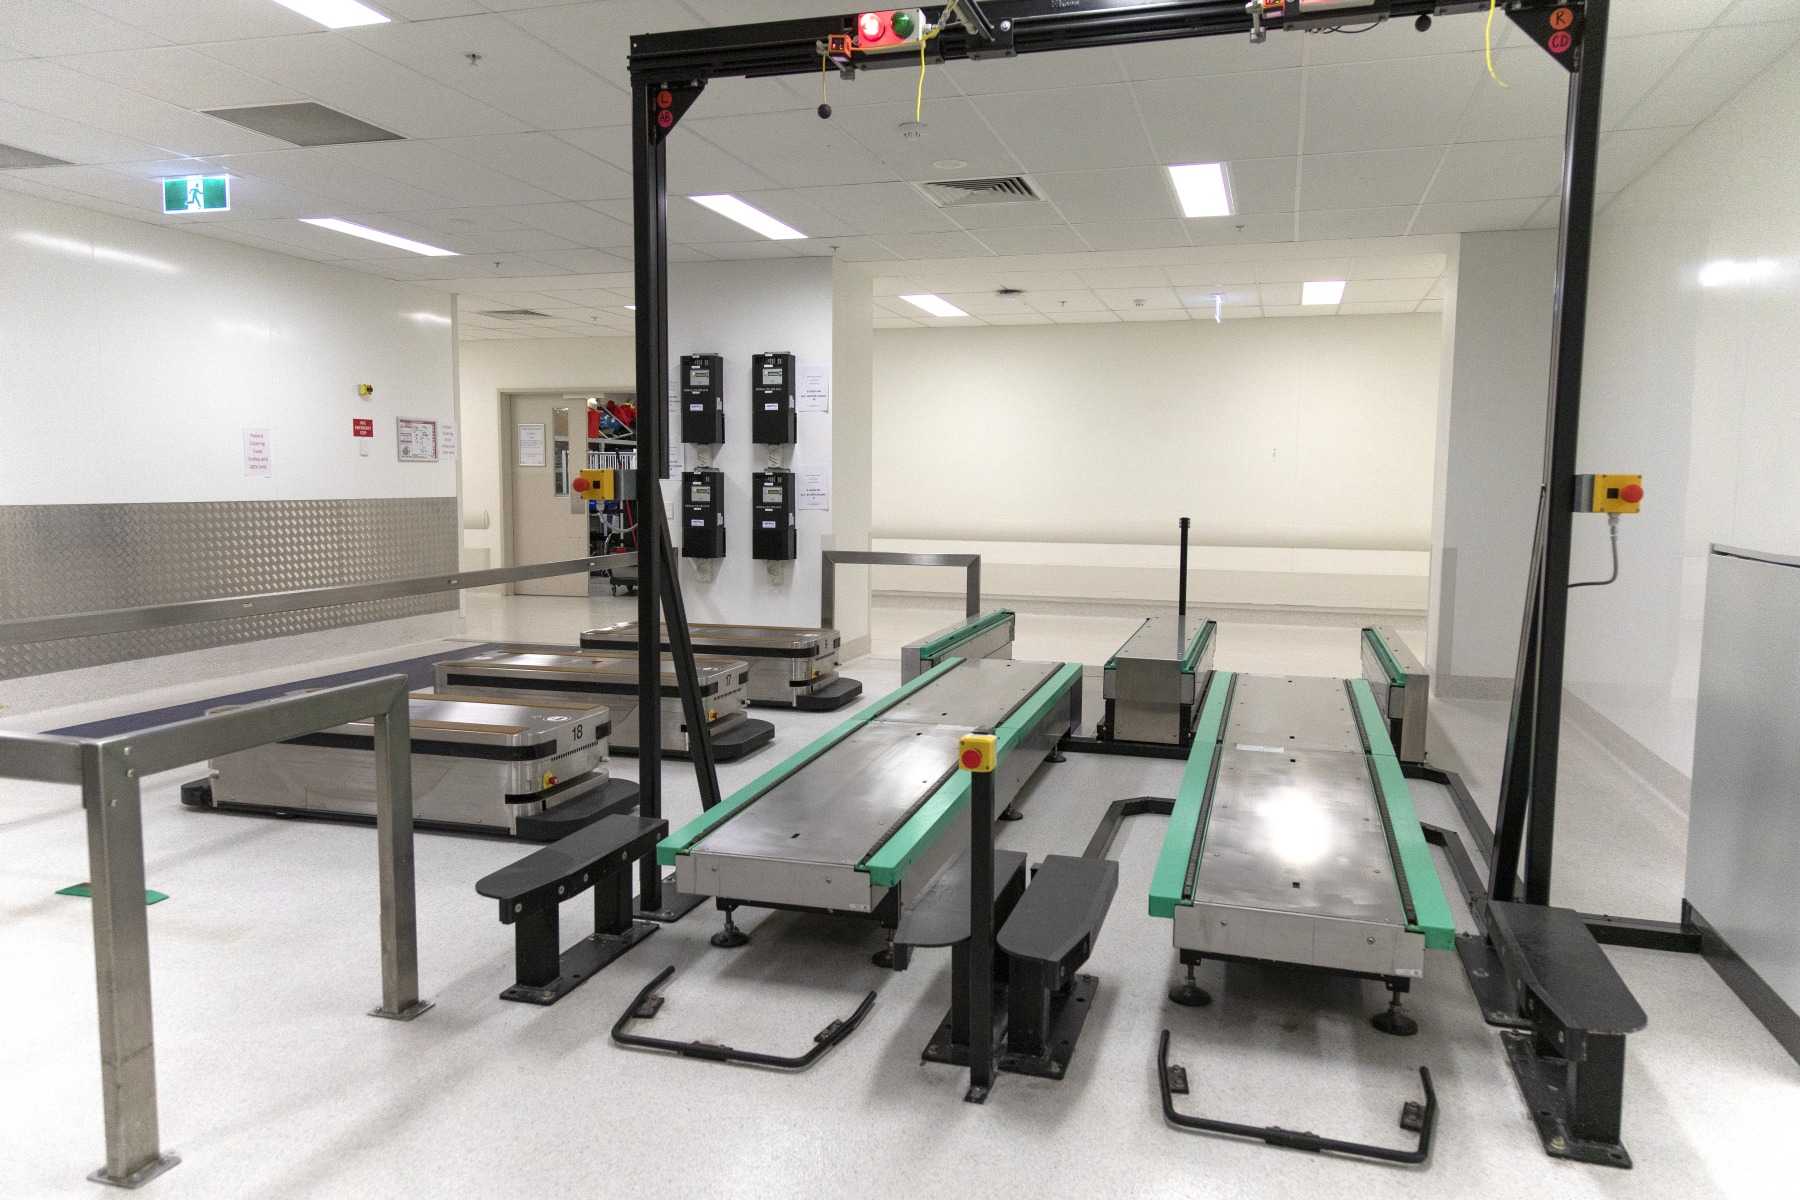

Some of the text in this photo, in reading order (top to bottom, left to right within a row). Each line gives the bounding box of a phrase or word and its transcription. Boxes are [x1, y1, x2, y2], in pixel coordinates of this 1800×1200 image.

[1555, 10, 1566, 25] R
[1552, 34, 1569, 48] CD
[661, 92, 669, 104] L
[660, 111, 671, 123] AB
[725, 674, 732, 686] 17
[571, 724, 583, 741] 18
